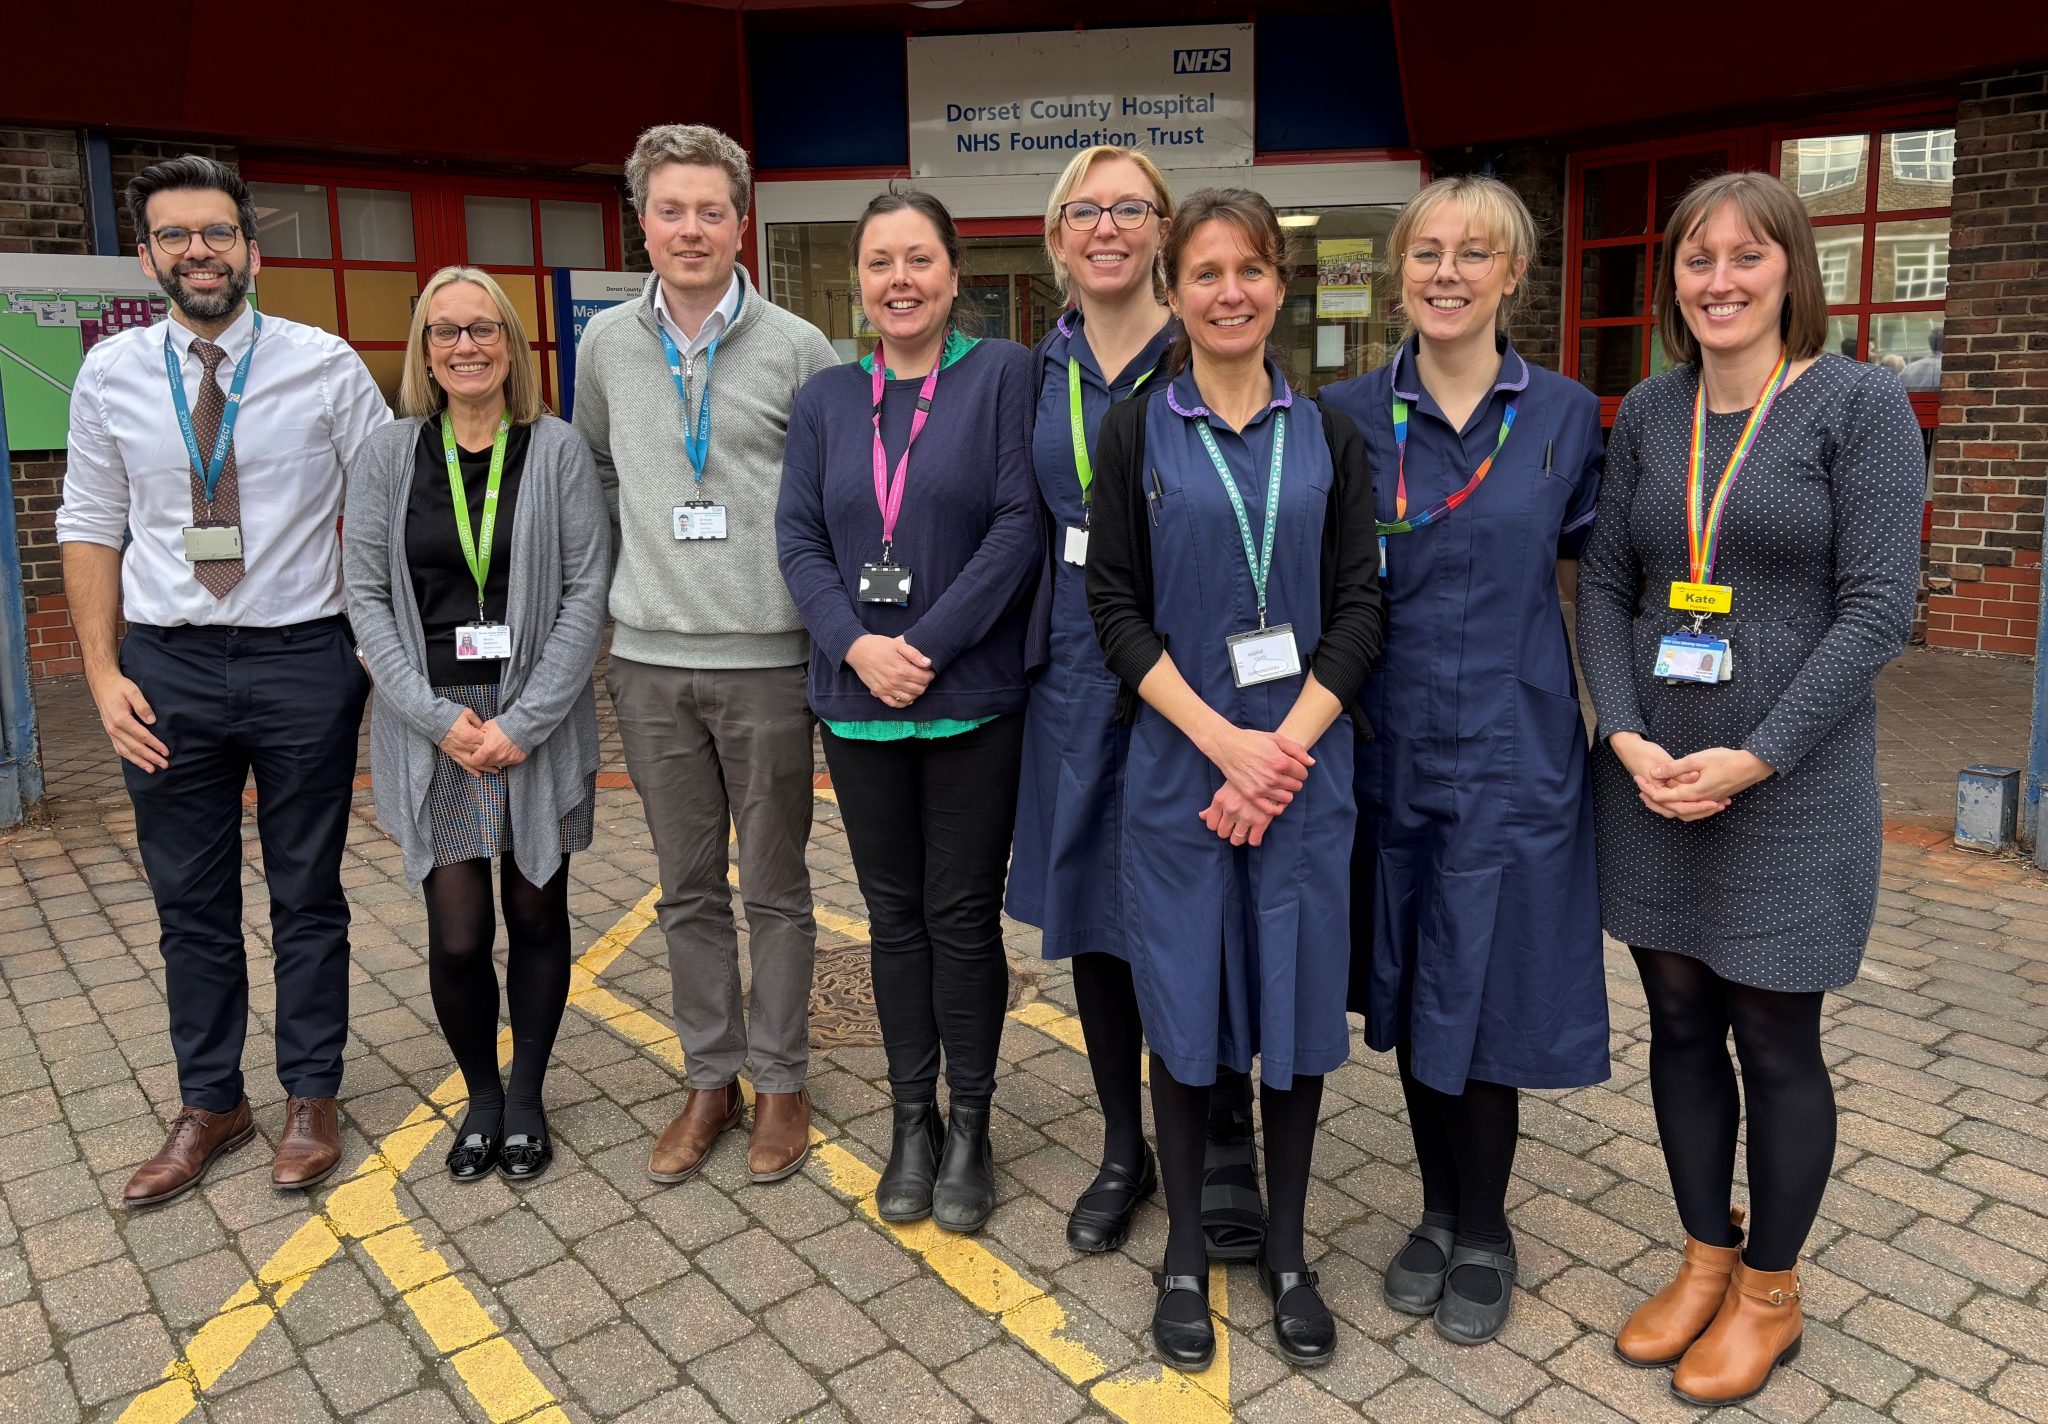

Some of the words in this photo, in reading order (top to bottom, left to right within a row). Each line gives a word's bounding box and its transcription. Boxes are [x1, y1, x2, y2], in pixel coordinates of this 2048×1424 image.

[1175, 50, 1229, 72] NHS
[946, 101, 1021, 123] Dorset
[1029, 98, 1112, 121] County
[1122, 92, 1215, 117] Hospital
[956, 132, 1001, 152] NHS
[1010, 128, 1137, 150] Foundation
[1147, 126, 1205, 146] Trust
[573, 304, 604, 318] Mai
[178, 409, 198, 459] EXCELLENCE
[214, 423, 232, 461] RESPECT
[1072, 414, 1085, 457] INTEGRITY
[458, 521, 475, 561] INTEGRITY
[481, 512, 494, 560] TEAMWORK
[1685, 593, 1716, 605] Kate
